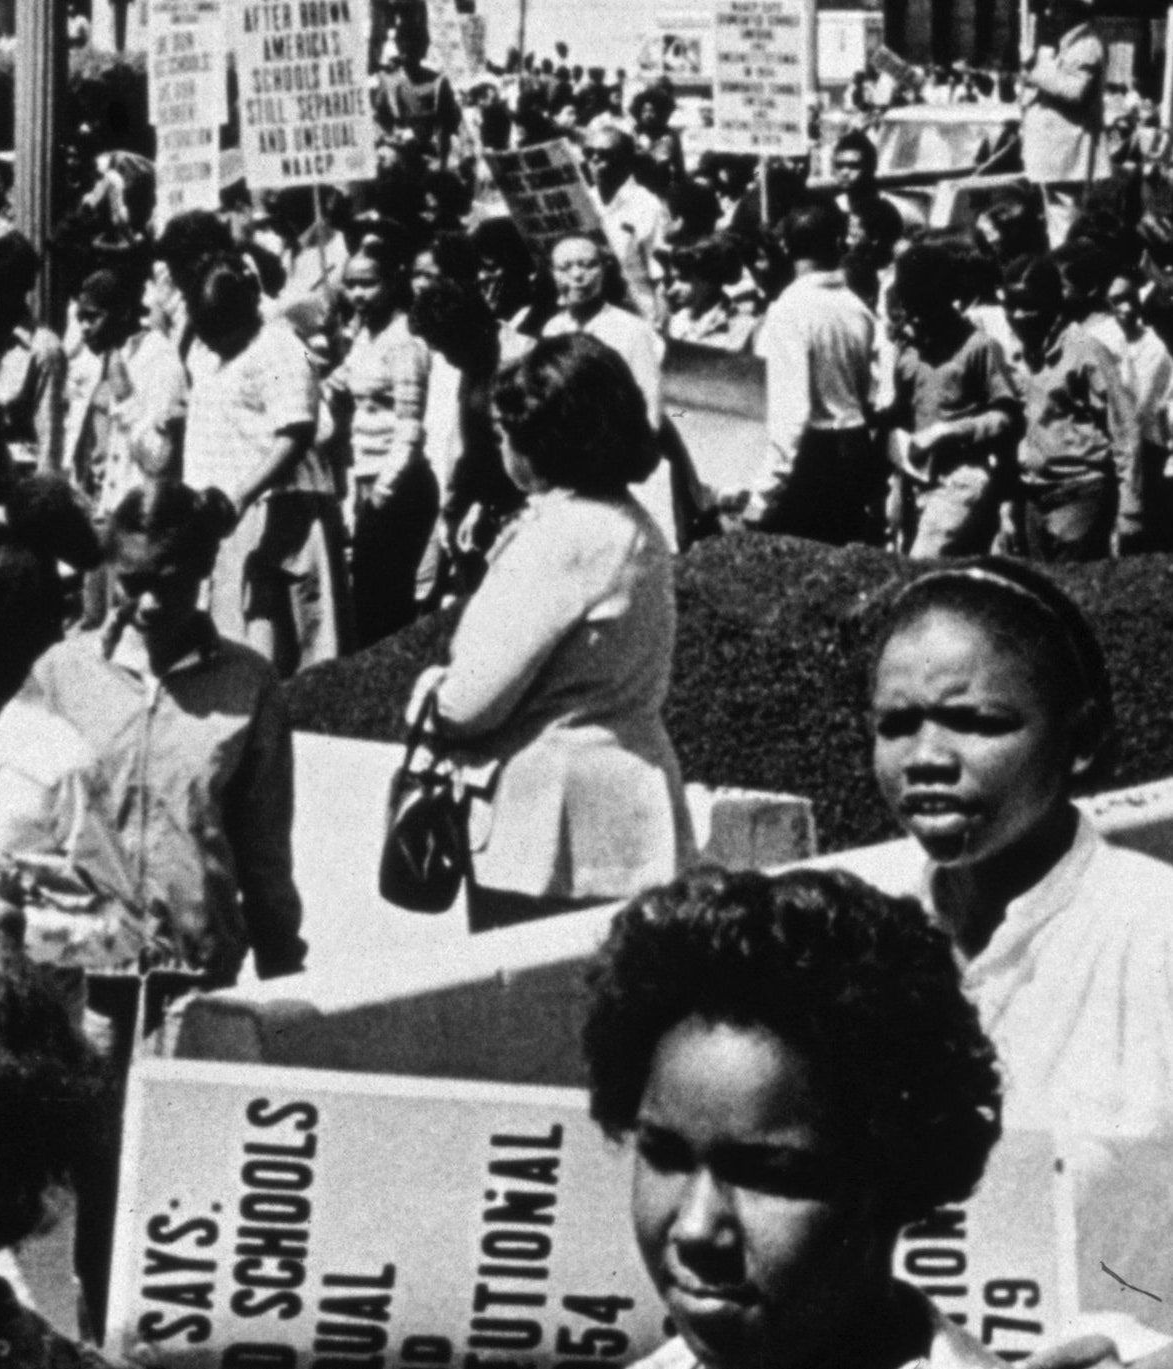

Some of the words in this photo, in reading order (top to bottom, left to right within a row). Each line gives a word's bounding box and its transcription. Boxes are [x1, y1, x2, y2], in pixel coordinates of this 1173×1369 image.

[244, 1, 292, 33] AFTER
[252, 61, 321, 93] SCHOOLS
[328, 57, 354, 88] ARE
[246, 96, 288, 127] STILL
[296, 87, 366, 121] SEPARATE
[259, 126, 287, 154] AND
[281, 152, 335, 177] NAACP
[229, 1096, 319, 1321] SCHOOLS
[136, 1197, 223, 1345] SAYS:
[900, 1207, 969, 1327] ION
[554, 1293, 636, 1369] 54
[981, 1277, 1044, 1363] 79
